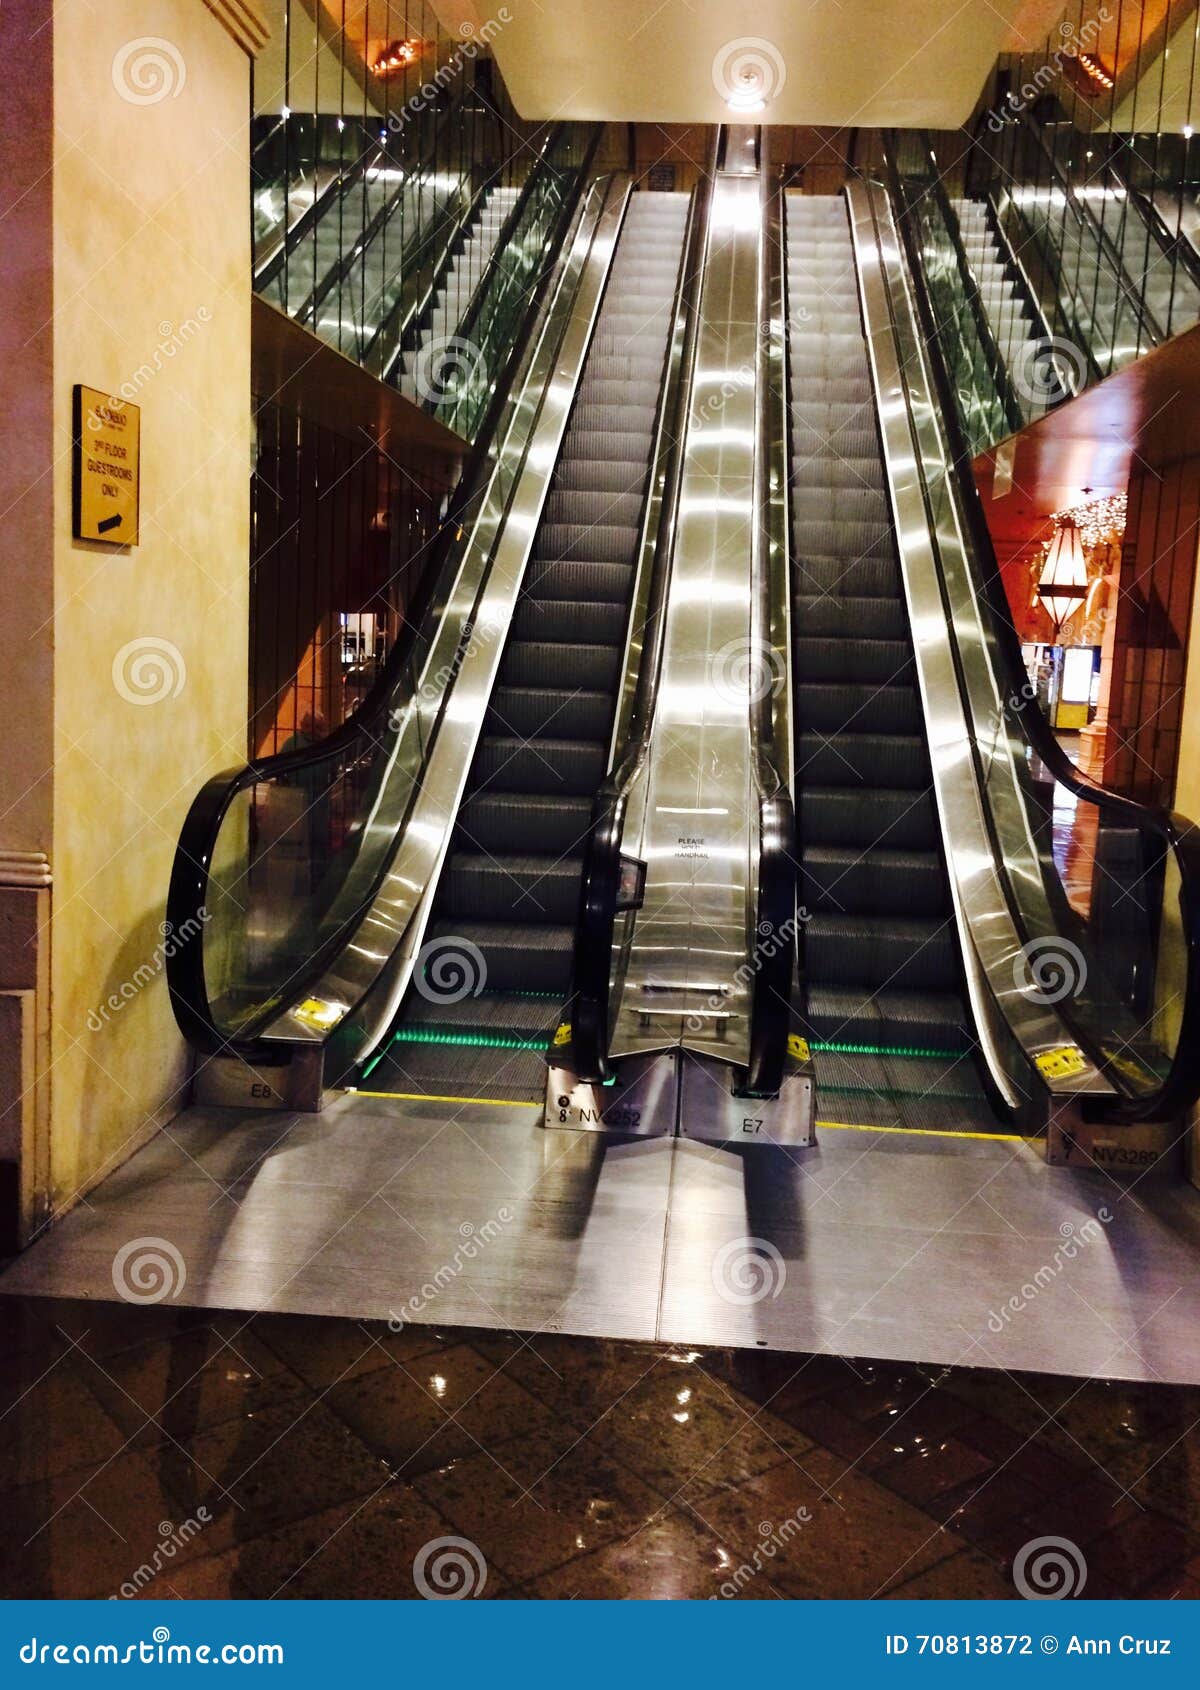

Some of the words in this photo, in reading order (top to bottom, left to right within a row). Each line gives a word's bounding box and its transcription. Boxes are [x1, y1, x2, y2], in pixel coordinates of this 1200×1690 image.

[105, 442, 127, 460] FLOOR
[88, 458, 133, 481] GUESTROOMS
[102, 483, 118, 498] ONLY
[252, 1083, 271, 1098] E8
[743, 1118, 763, 1134] E7
